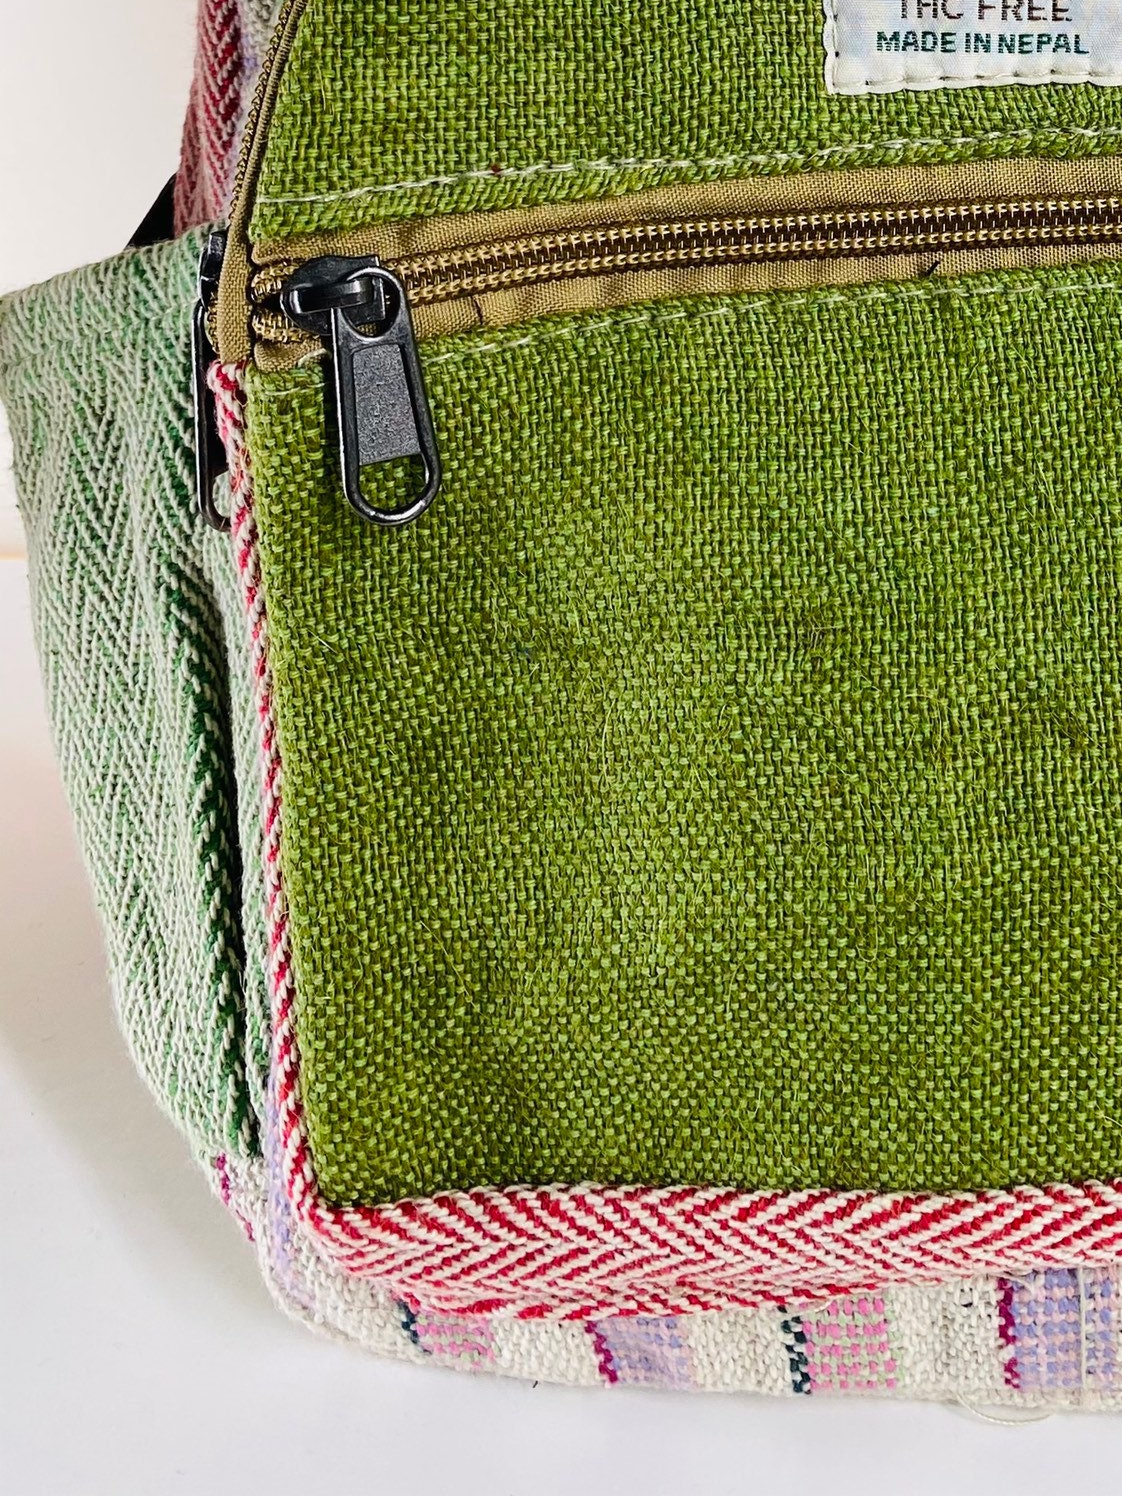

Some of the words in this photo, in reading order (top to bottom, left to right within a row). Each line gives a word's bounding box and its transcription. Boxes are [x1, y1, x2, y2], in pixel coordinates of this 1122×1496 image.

[876, 31, 957, 54] MADE
[965, 32, 991, 54] IN
[998, 33, 1090, 55] NEPAL
